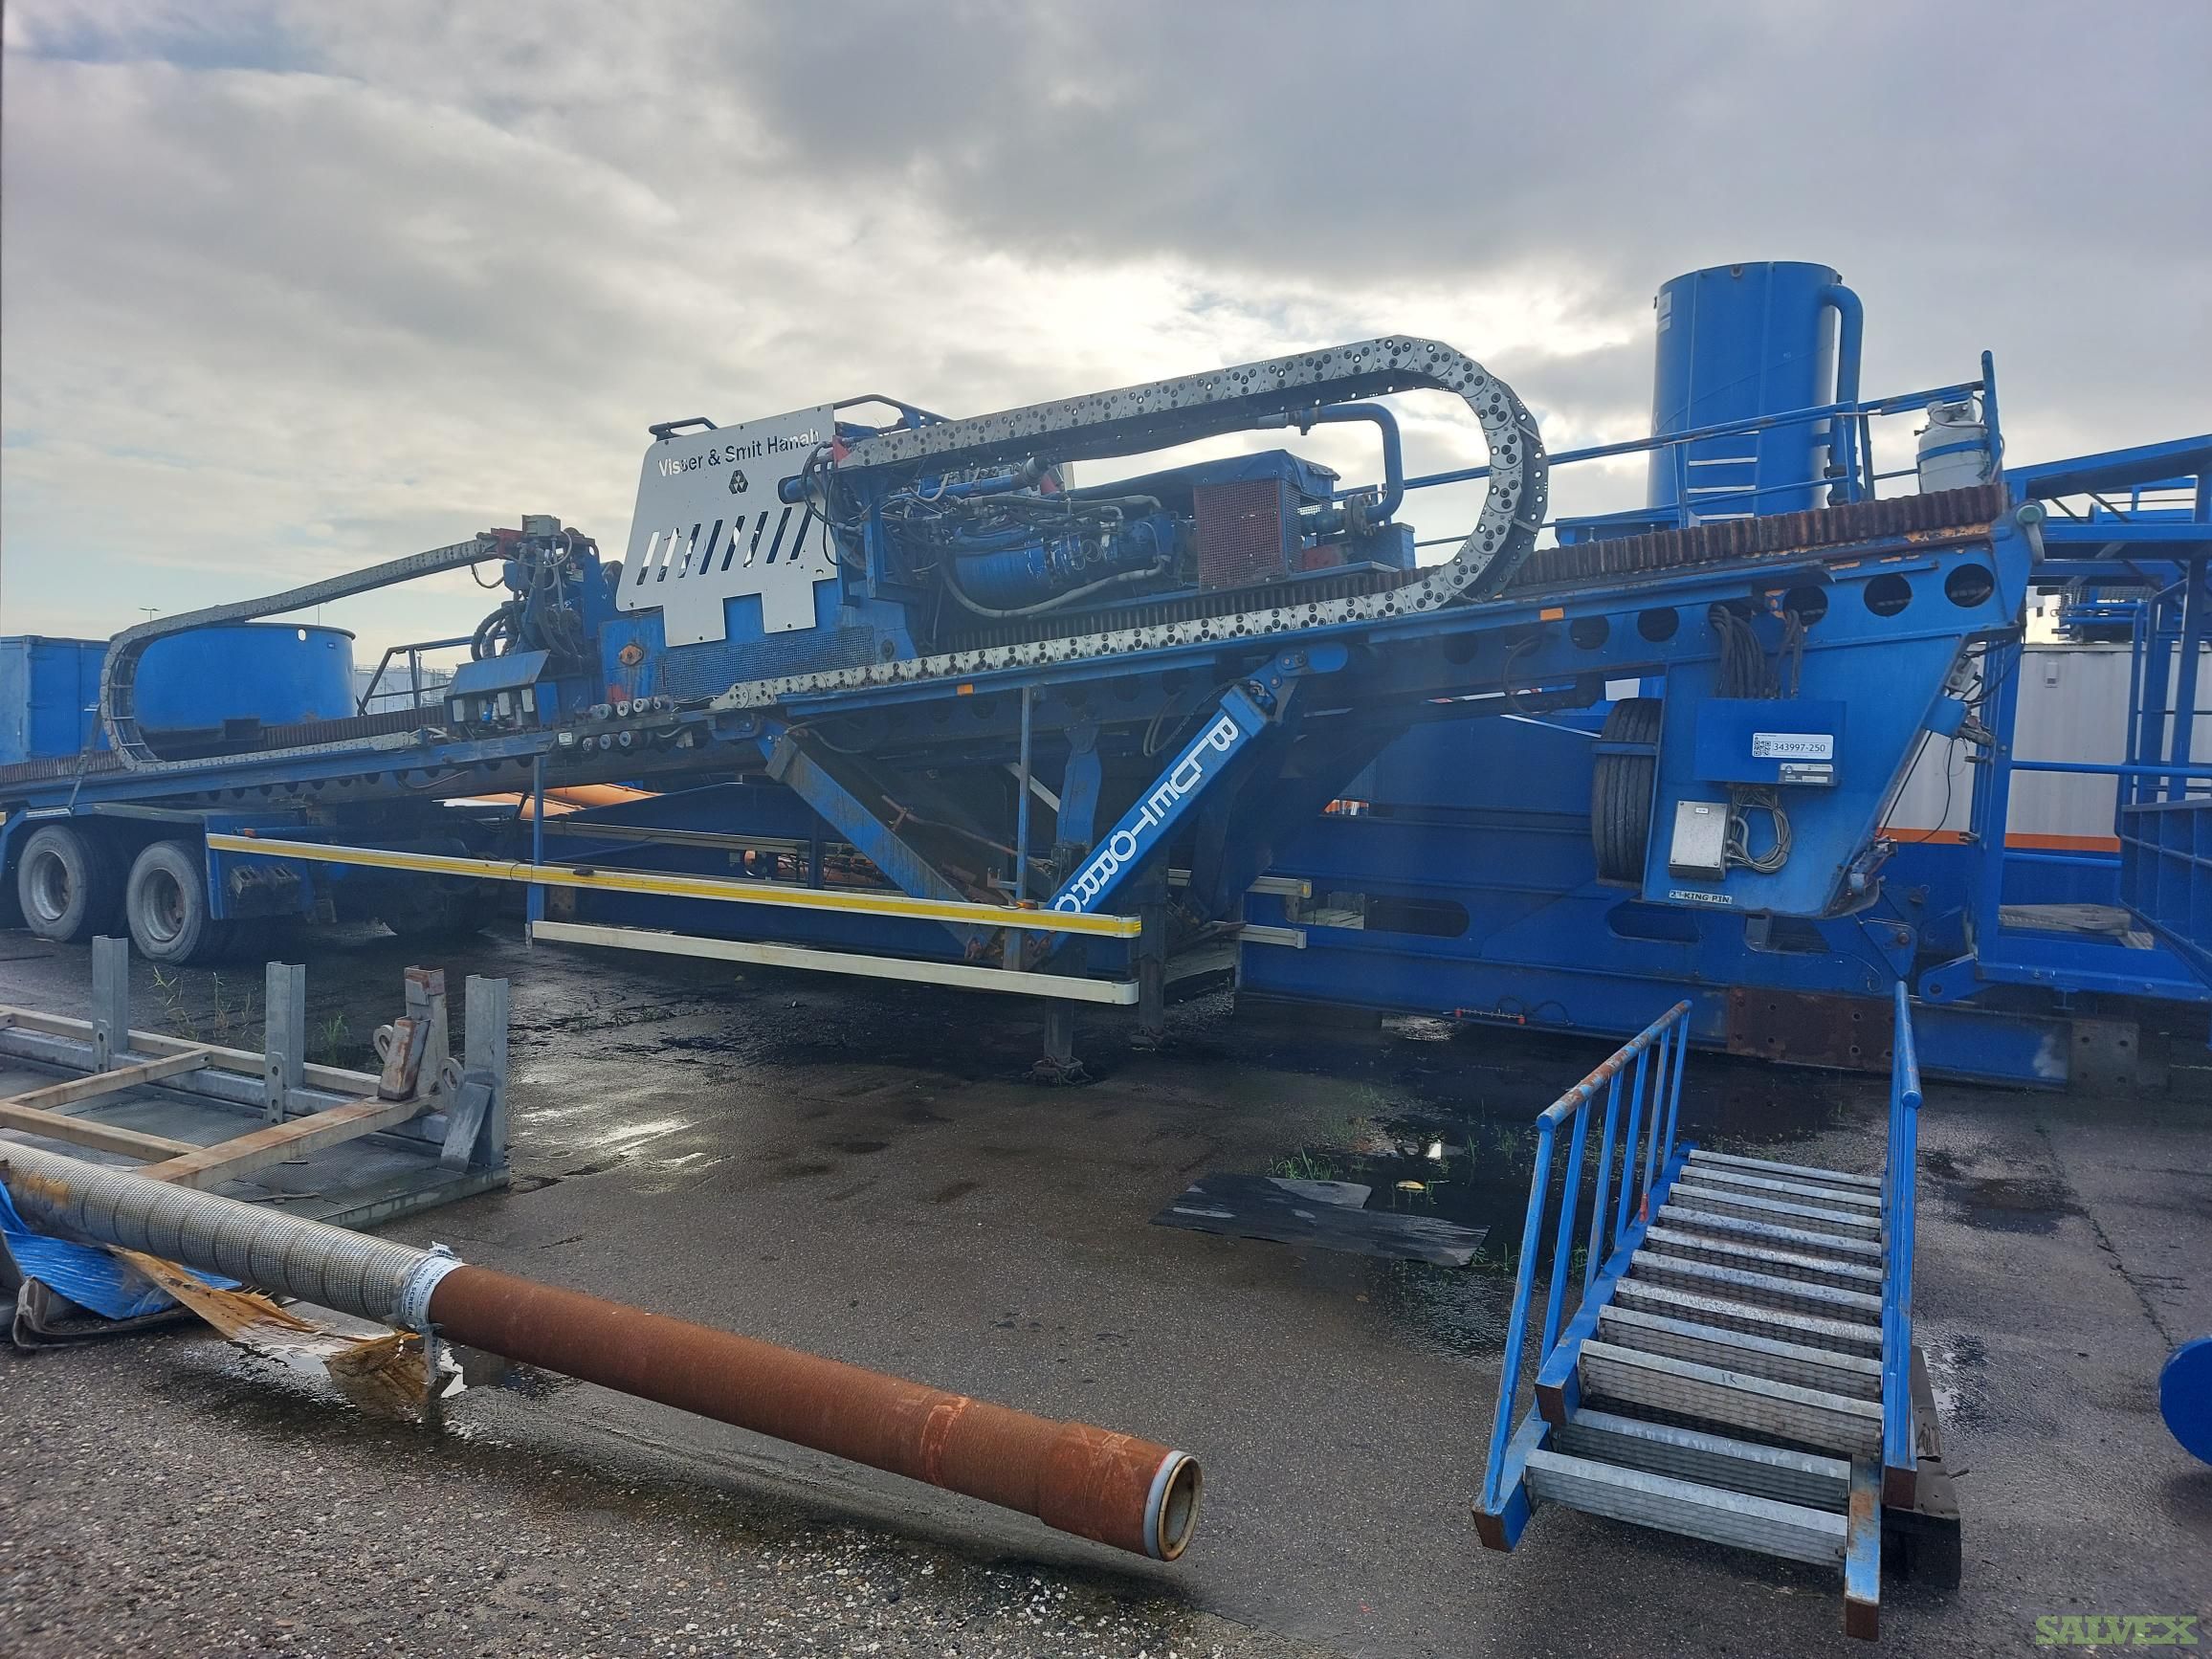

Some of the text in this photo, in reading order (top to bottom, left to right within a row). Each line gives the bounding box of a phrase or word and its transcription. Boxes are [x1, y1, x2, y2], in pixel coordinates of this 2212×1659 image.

[658, 429, 820, 476] Visser & Smit Hanab
[1773, 742, 1826, 753] 343997-250
[1712, 895, 1730, 903] PIN
[408, 1268, 431, 1316] WELL SCREEN
